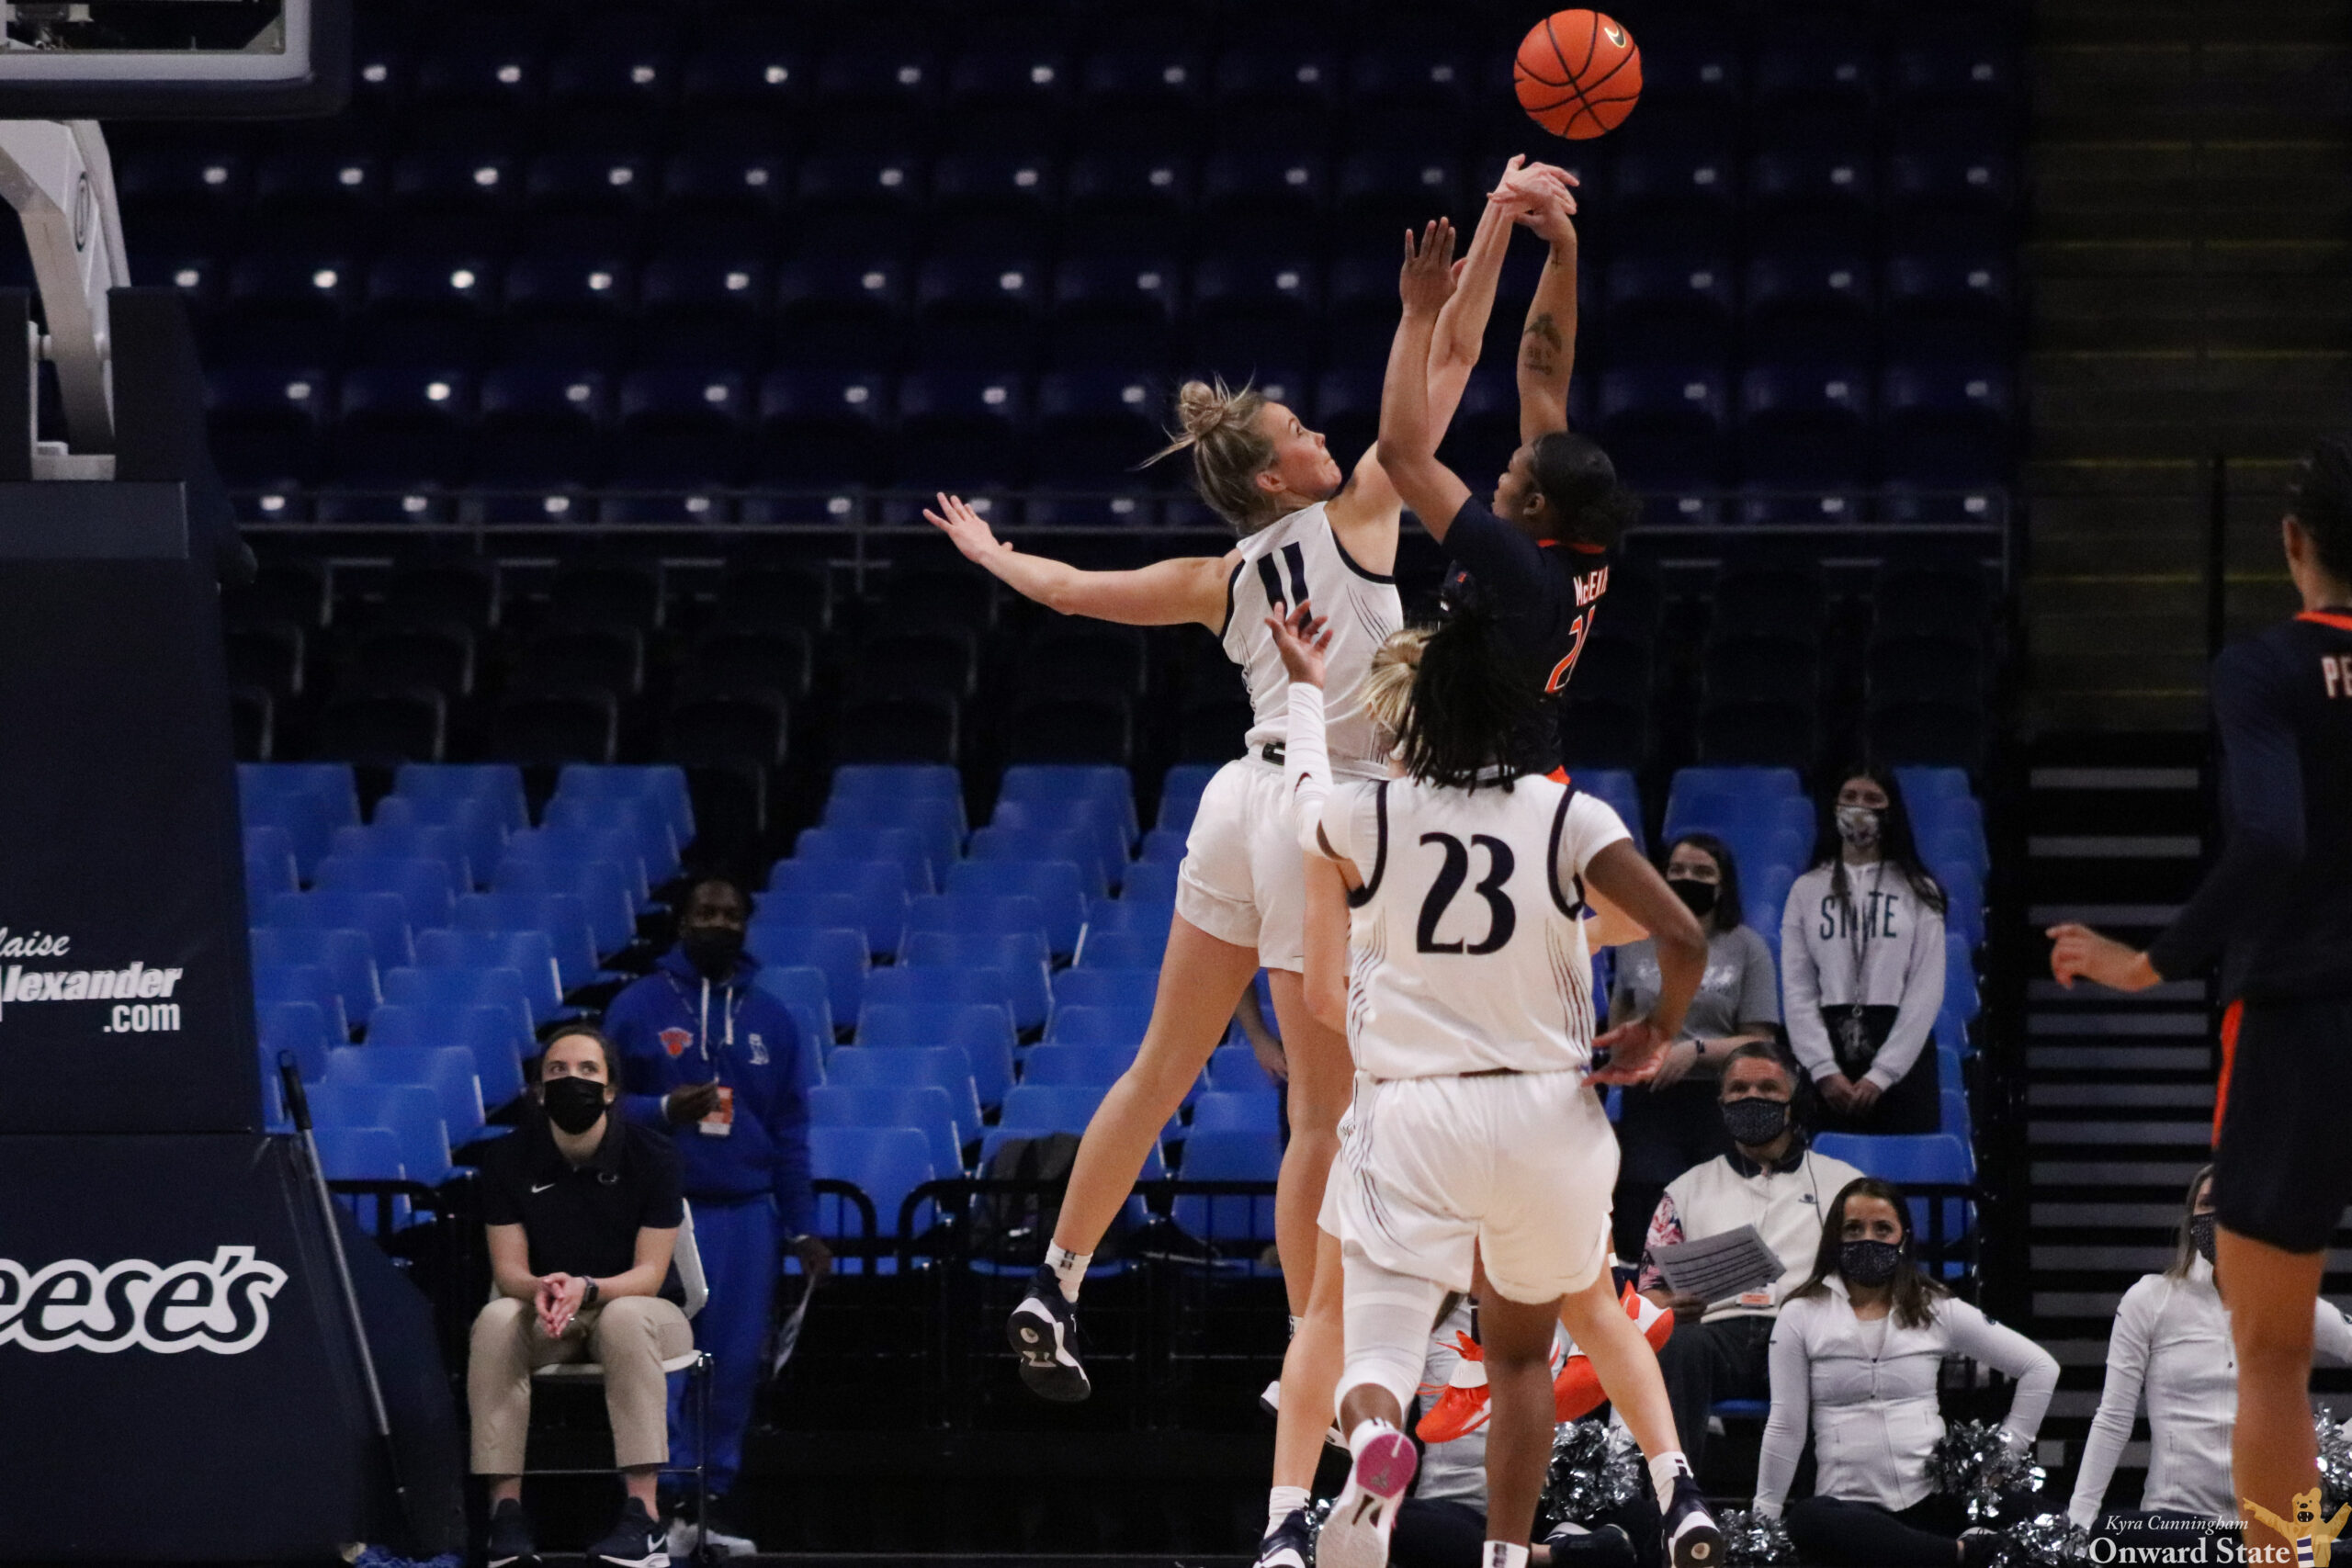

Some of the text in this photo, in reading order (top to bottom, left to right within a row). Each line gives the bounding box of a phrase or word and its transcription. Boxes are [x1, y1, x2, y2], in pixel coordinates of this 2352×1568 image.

[1416, 831, 1516, 954] 23
[0, 961, 184, 1003] lexander
[103, 1003, 181, 1032] .com
